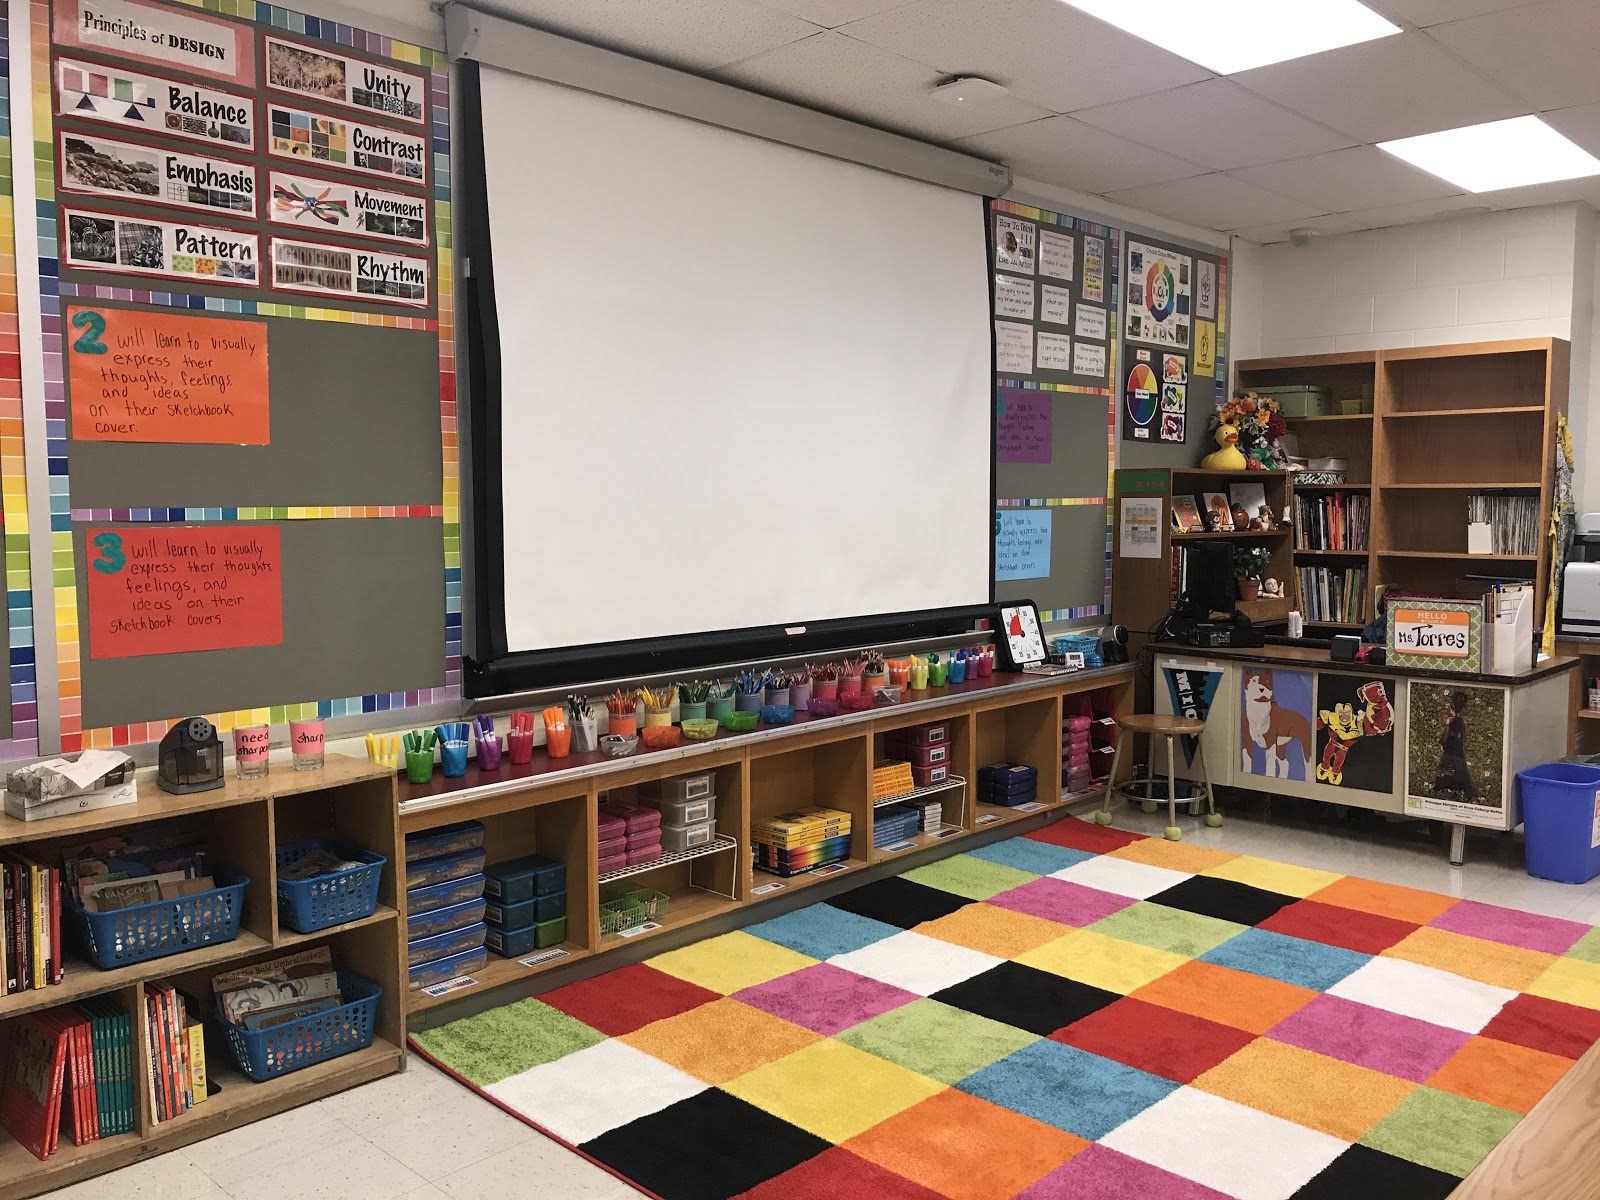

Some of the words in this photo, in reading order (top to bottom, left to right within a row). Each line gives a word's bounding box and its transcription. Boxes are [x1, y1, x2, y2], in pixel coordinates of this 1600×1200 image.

[84, 10, 147, 41] Principles
[151, 33, 165, 45] of
[168, 34, 226, 61] DESIGN
[363, 67, 411, 100] Unity
[168, 87, 247, 125] Balance
[353, 128, 424, 162] Contrast
[166, 157, 253, 193] Emphasis
[354, 191, 424, 219] Movement
[1020, 222, 1033, 234] Think
[175, 229, 252, 260] Pattern
[357, 255, 425, 285] Rhythm
[72, 310, 108, 355] 2
[118, 327, 144, 348] will
[154, 328, 181, 348] learn
[187, 332, 200, 350] to
[212, 336, 256, 357] visually
[113, 354, 170, 368] express
[183, 355, 214, 368] their
[101, 367, 174, 390] thoughts,
[103, 386, 128, 398] and
[153, 387, 189, 399] ideas
[90, 404, 108, 417] on
[126, 400, 158, 416] their
[93, 532, 126, 574] 3
[132, 538, 157, 558] will
[167, 539, 198, 557] learn
[205, 540, 216, 555] to
[224, 539, 264, 560] visually
[131, 564, 176, 578] express
[188, 562, 215, 573] their
[126, 578, 196, 600] feelings,
[204, 576, 228, 590] and
[132, 597, 172, 612] ideas
[188, 599, 204, 609] on
[212, 594, 244, 607] their
[188, 614, 222, 626] covers
[1399, 632, 1414, 643] Ms.
[1412, 624, 1465, 648] Torres
[242, 731, 268, 743] need
[296, 732, 324, 744] sharp
[1408, 798, 1423, 808] art
[104, 890, 124, 899] VAN
[127, 884, 157, 896] GOGH
